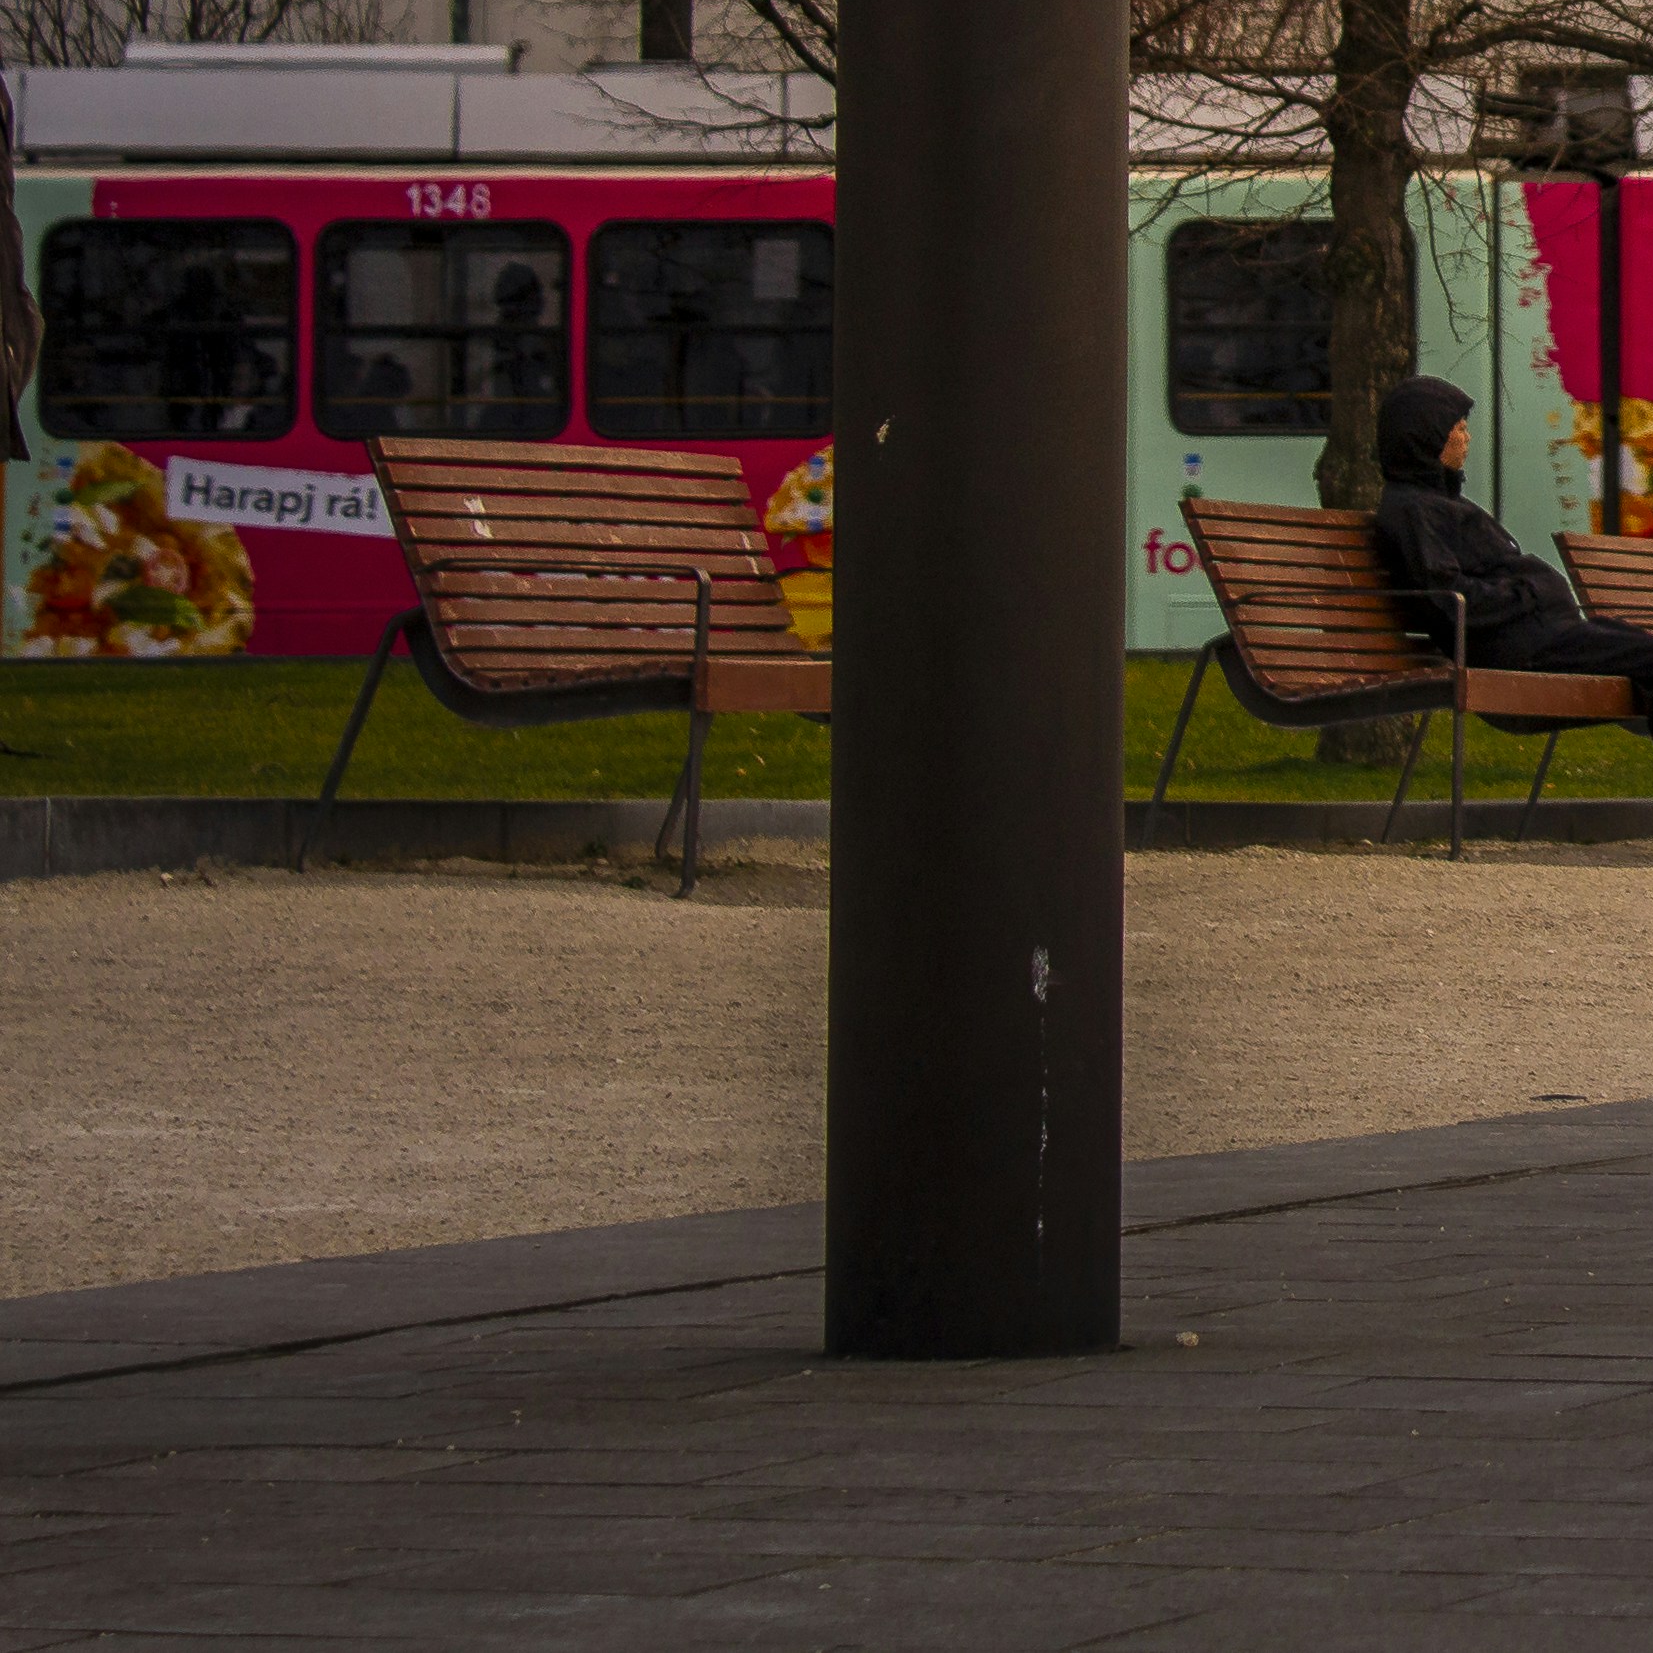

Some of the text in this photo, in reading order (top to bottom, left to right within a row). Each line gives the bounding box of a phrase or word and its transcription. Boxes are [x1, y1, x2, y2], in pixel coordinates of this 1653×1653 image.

[405, 183, 491, 218] 1348
[182, 472, 377, 524] Harapj rá!
